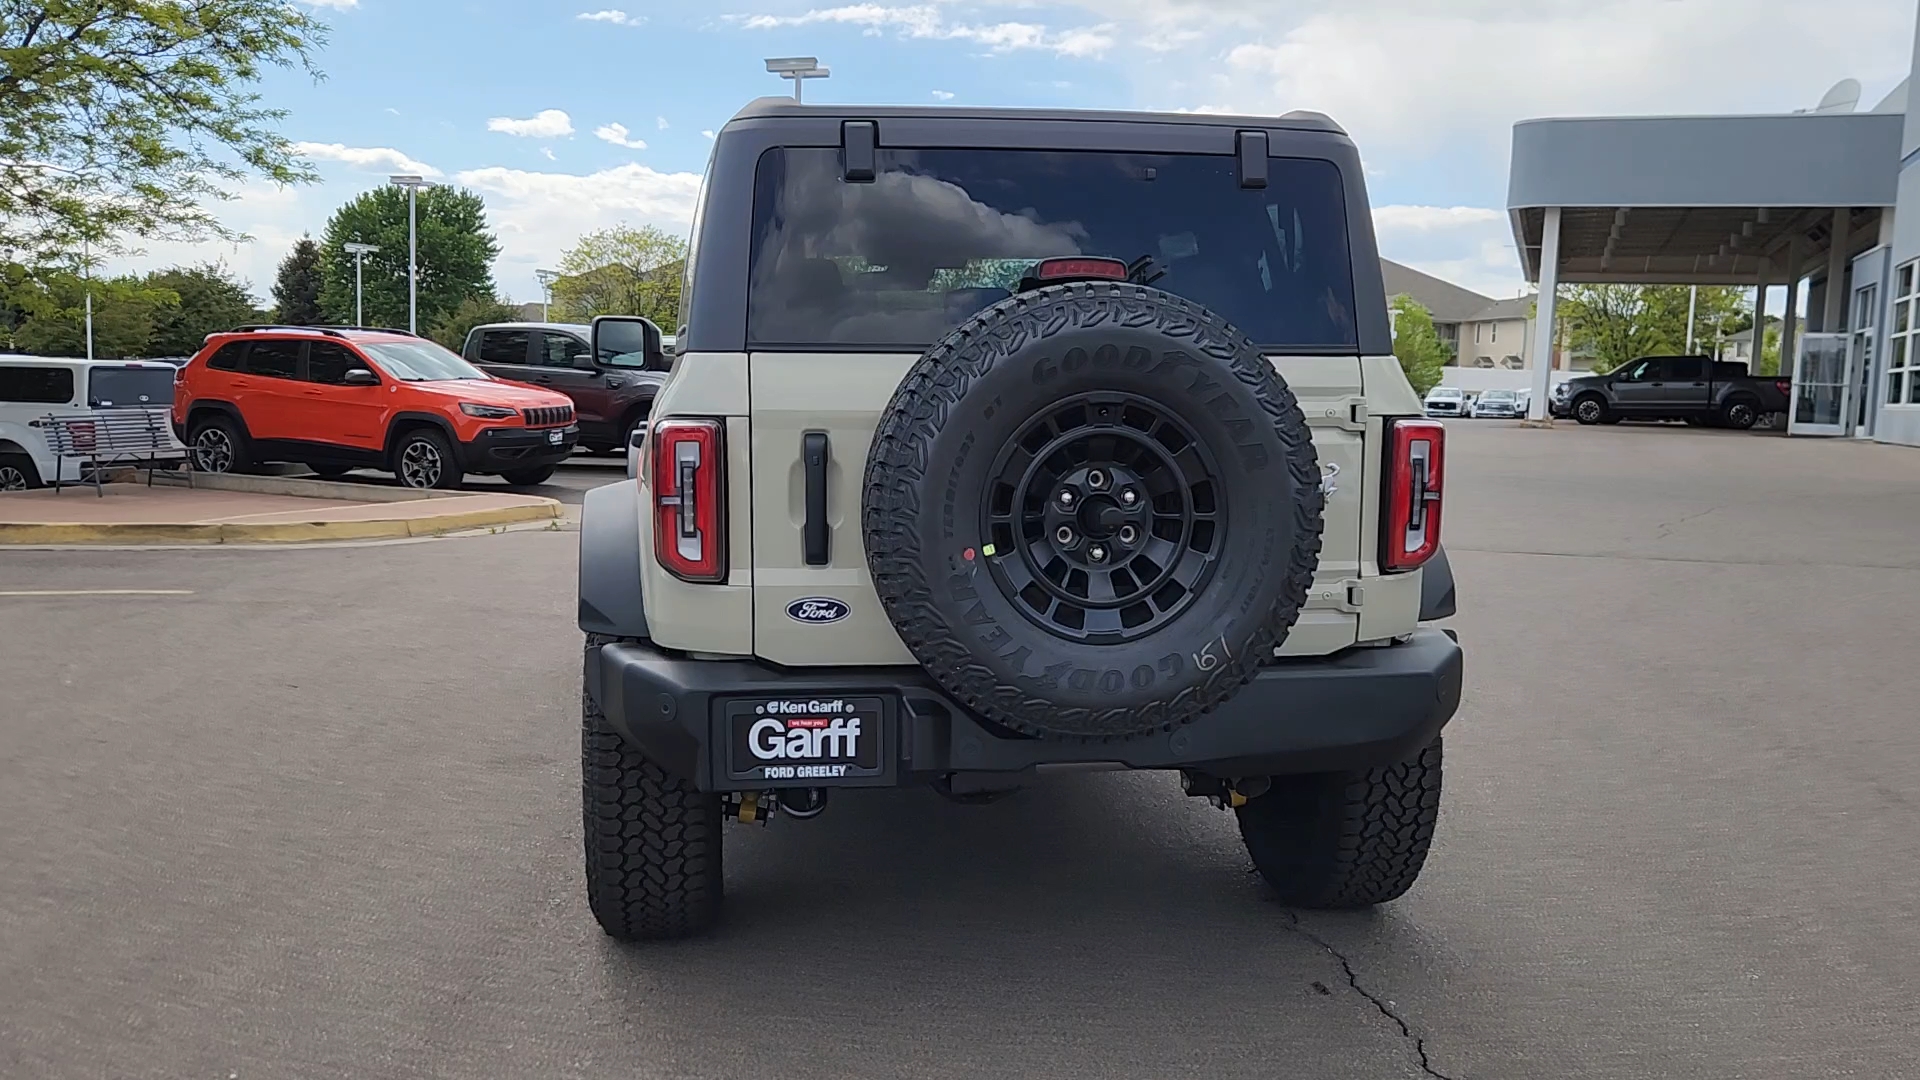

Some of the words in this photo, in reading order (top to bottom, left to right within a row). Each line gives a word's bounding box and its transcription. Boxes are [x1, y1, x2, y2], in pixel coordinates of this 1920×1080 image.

[1032, 344, 1269, 474] GOODYEAR
[798, 601, 839, 619] Ford
[946, 573, 1185, 695] GOODYEAR
[779, 701, 807, 714] Ken
[808, 700, 843, 714] Garff
[748, 717, 861, 760] Garff
[764, 767, 795, 779] FORD
[797, 765, 847, 778] GREELEY
